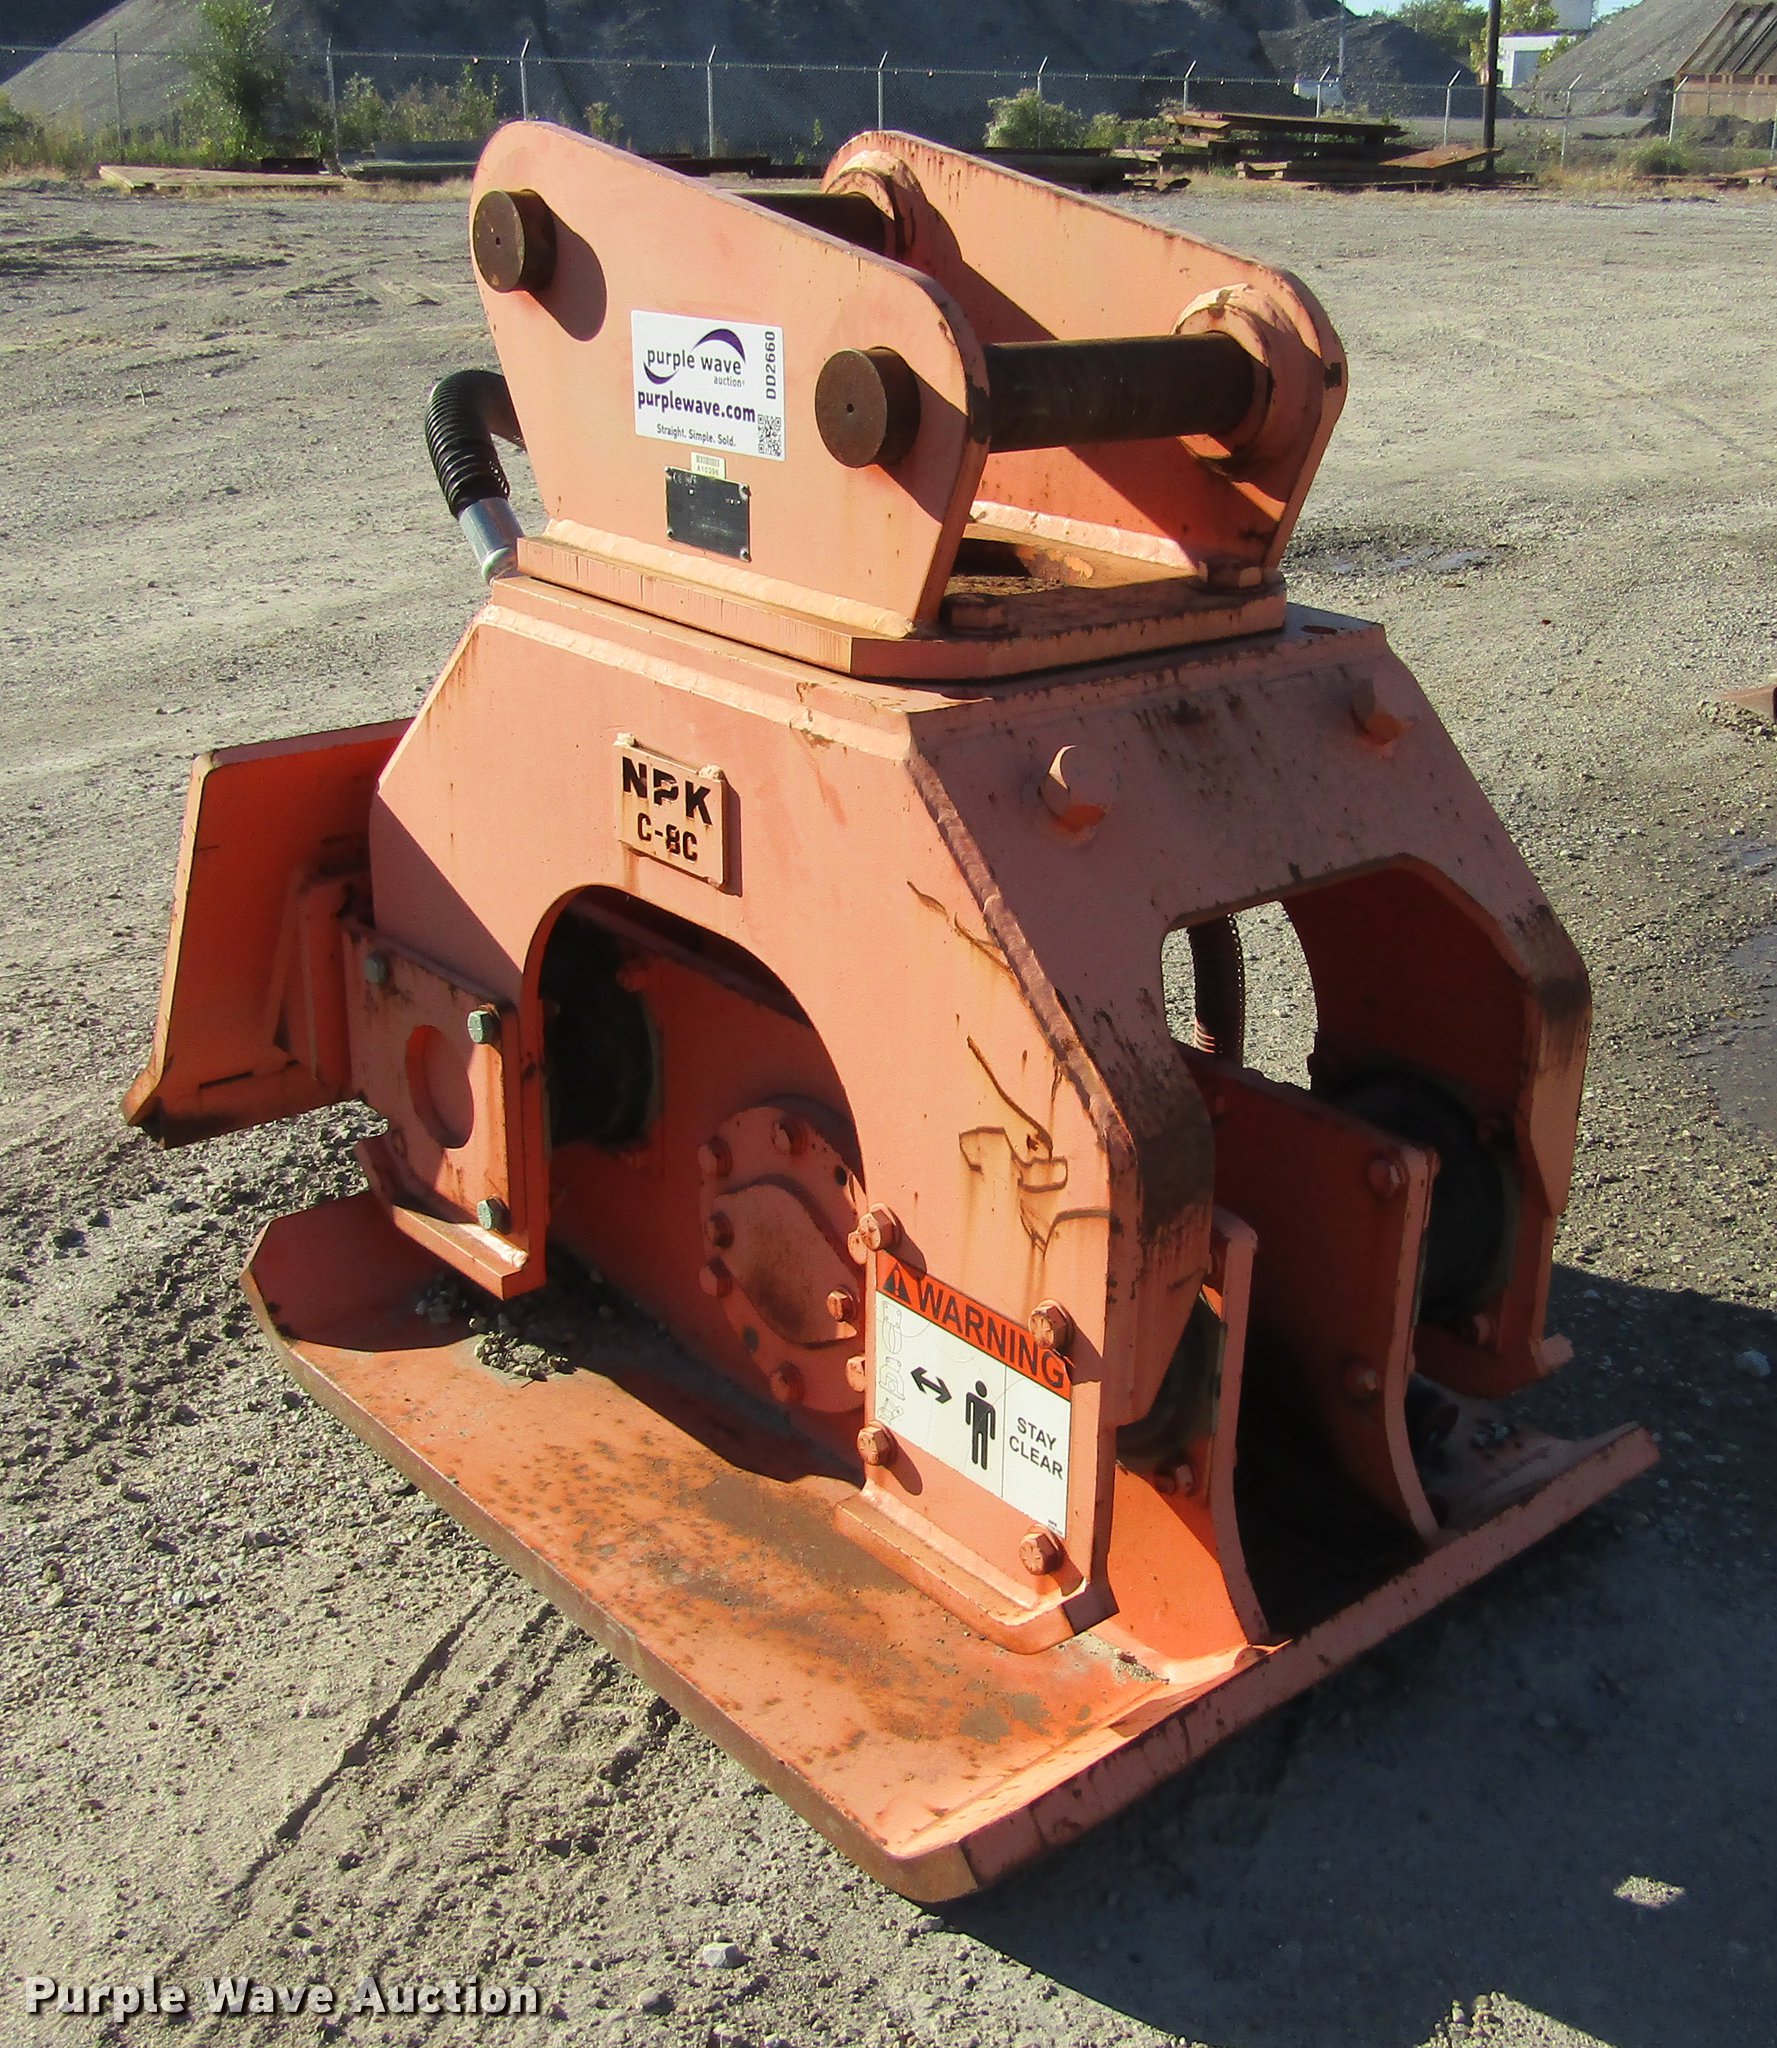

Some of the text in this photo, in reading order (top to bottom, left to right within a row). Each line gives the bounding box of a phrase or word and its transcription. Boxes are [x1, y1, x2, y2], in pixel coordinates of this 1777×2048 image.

[647, 349, 742, 375] purple wave
[713, 375, 742, 388] auction
[764, 331, 777, 400] DD2660
[637, 390, 756, 423] purplewave.com
[656, 423, 736, 447] Straight. Simple. Sold.
[622, 756, 713, 826] NPK
[637, 812, 698, 862] C-8C
[916, 1278, 1064, 1388] WARNING
[1017, 1416, 1057, 1451] STAY
[1009, 1434, 1063, 1480] CLEAR
